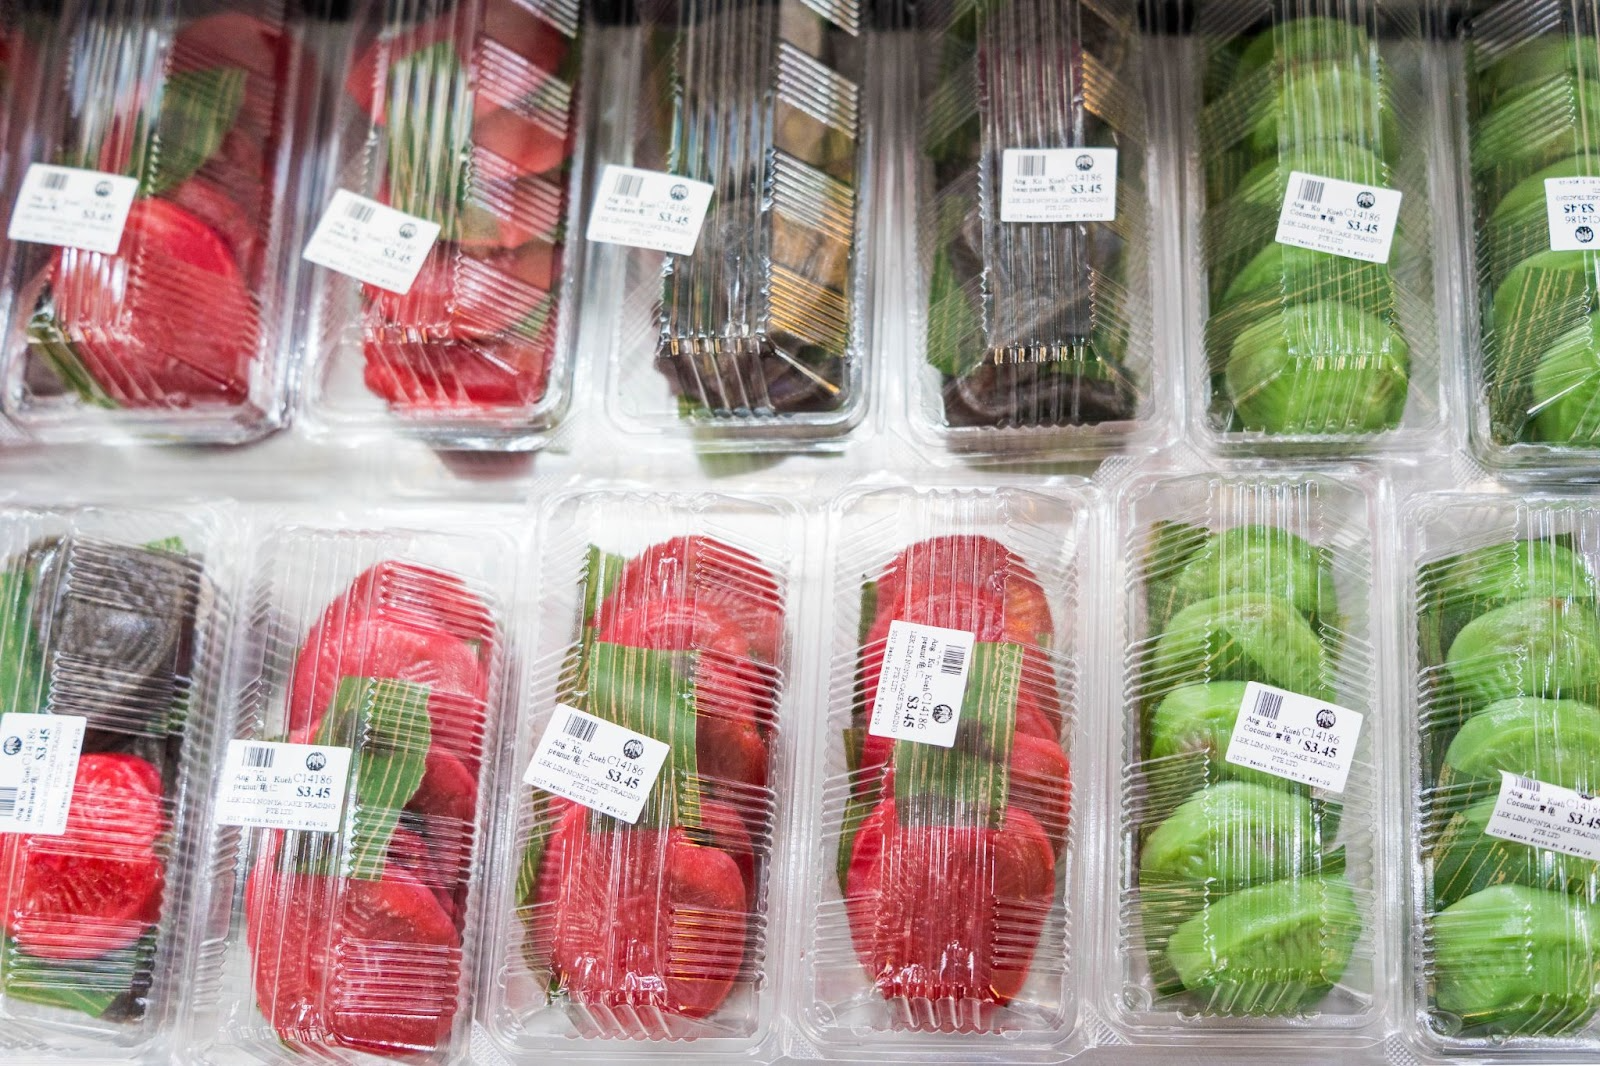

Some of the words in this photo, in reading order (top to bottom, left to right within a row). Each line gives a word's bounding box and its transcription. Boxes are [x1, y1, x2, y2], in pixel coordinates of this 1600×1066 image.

[929, 639, 938, 652] Ang
[927, 658, 936, 668] Ku
[922, 674, 932, 692] Kueh
[903, 696, 919, 728] $3.45
[918, 692, 932, 730] C14186
[1246, 716, 1260, 726] Ang
[1266, 720, 1277, 730] Ku
[1283, 726, 1301, 736] Kueh
[1302, 727, 1340, 744] C14186
[552, 740, 567, 750] Ang
[572, 745, 583, 755] Ku
[588, 752, 606, 764] Kueh
[1235, 736, 1250, 745] LEK
[1250, 740, 1264, 749] LIM
[1264, 744, 1289, 756] NONYA
[1290, 752, 1308, 762] CAKE
[1310, 757, 1340, 770] TRADING
[1303, 741, 1337, 758] $3.45
[607, 756, 644, 776] C14186
[1271, 755, 1285, 764] PTE
[1285, 759, 1299, 768] LTD
[236, 775, 249, 783] Ang
[274, 776, 292, 784] Kueh
[294, 773, 332, 785] C14186
[538, 758, 553, 768] LEK
[552, 764, 567, 774] LIM
[566, 769, 590, 783] NONYA
[591, 779, 610, 790] CAKE
[610, 786, 640, 802] TRADING
[571, 780, 586, 790] PTE
[585, 785, 599, 795] LTD
[606, 769, 640, 789] $3.45
[297, 786, 330, 798] $3.45
[1509, 790, 1522, 799] Ang
[1547, 798, 1565, 808] Kueh
[1566, 798, 1600, 813] C1418
[1568, 812, 1600, 829] $3.45
[1573, 829, 1600, 840] TRADIN
